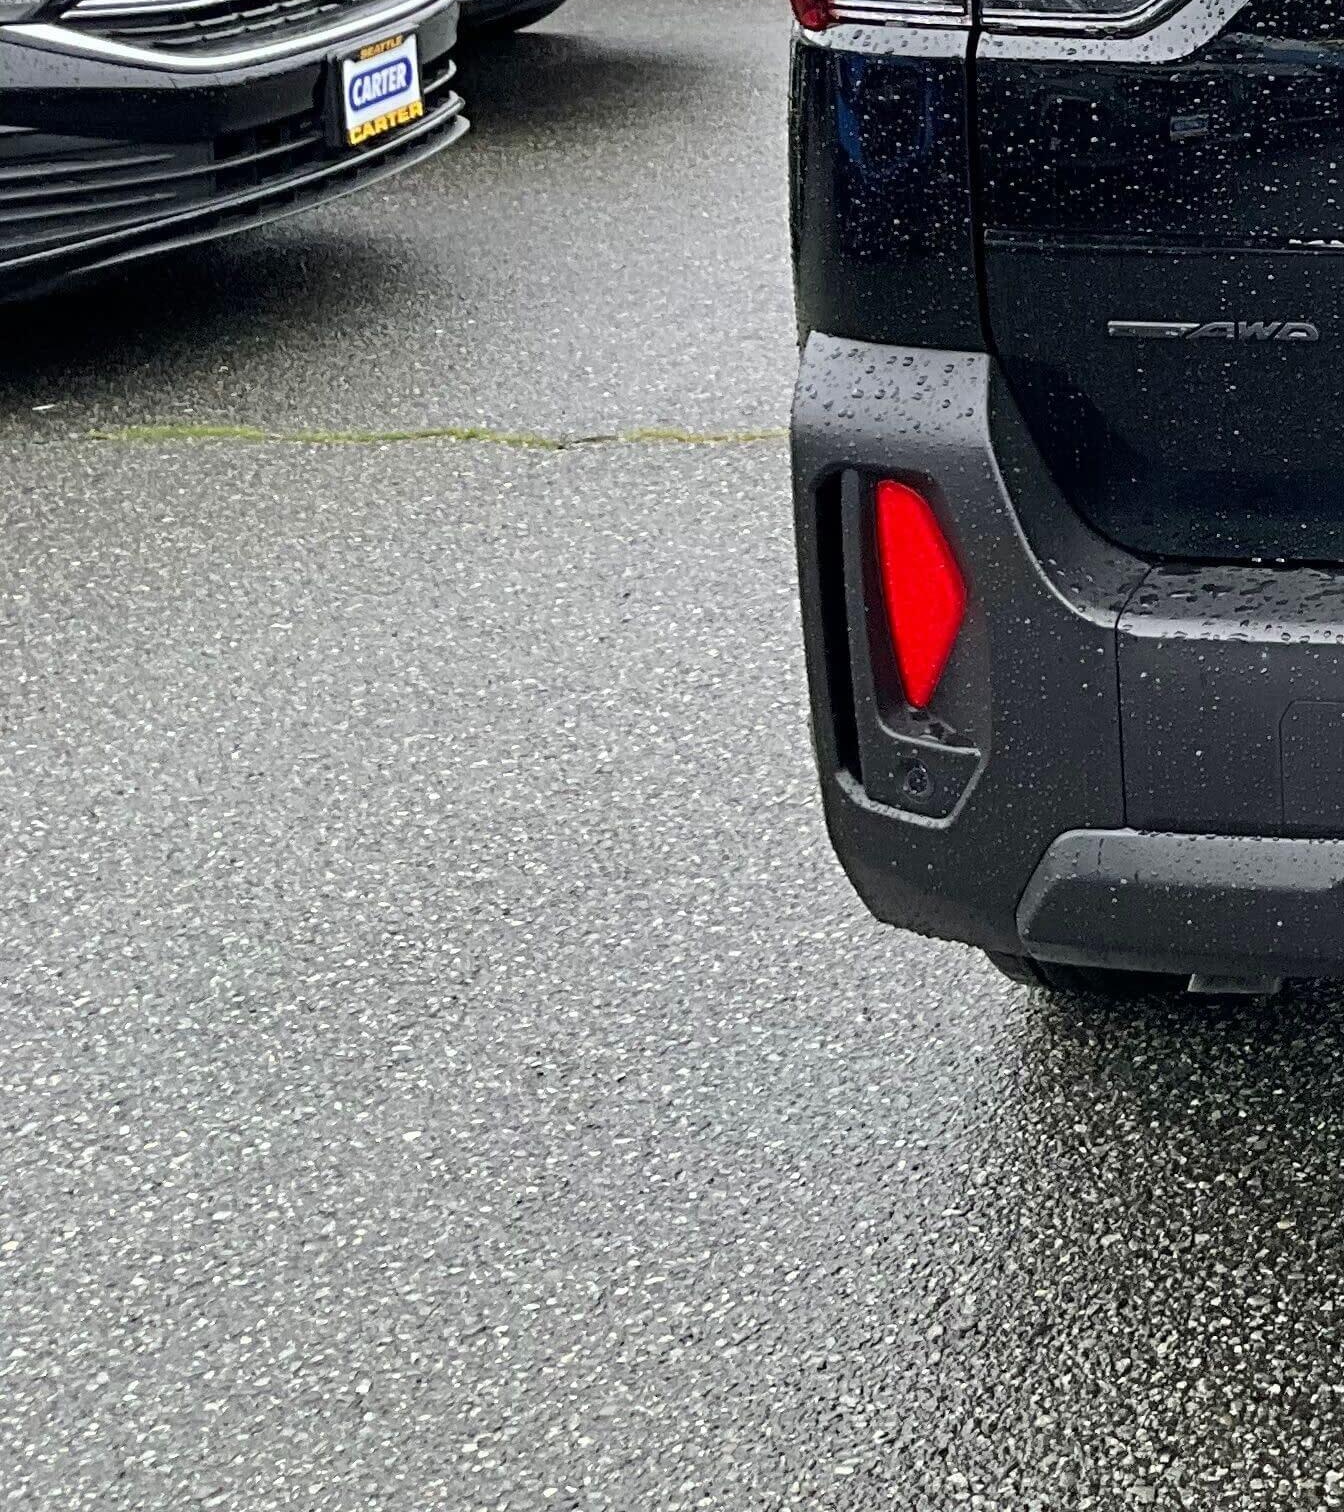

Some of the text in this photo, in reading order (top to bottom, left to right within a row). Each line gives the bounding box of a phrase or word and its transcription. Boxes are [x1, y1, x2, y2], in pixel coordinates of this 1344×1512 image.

[360, 35, 404, 60] SEATTLE
[352, 62, 408, 107] CARTER
[349, 100, 424, 146] CARTER
